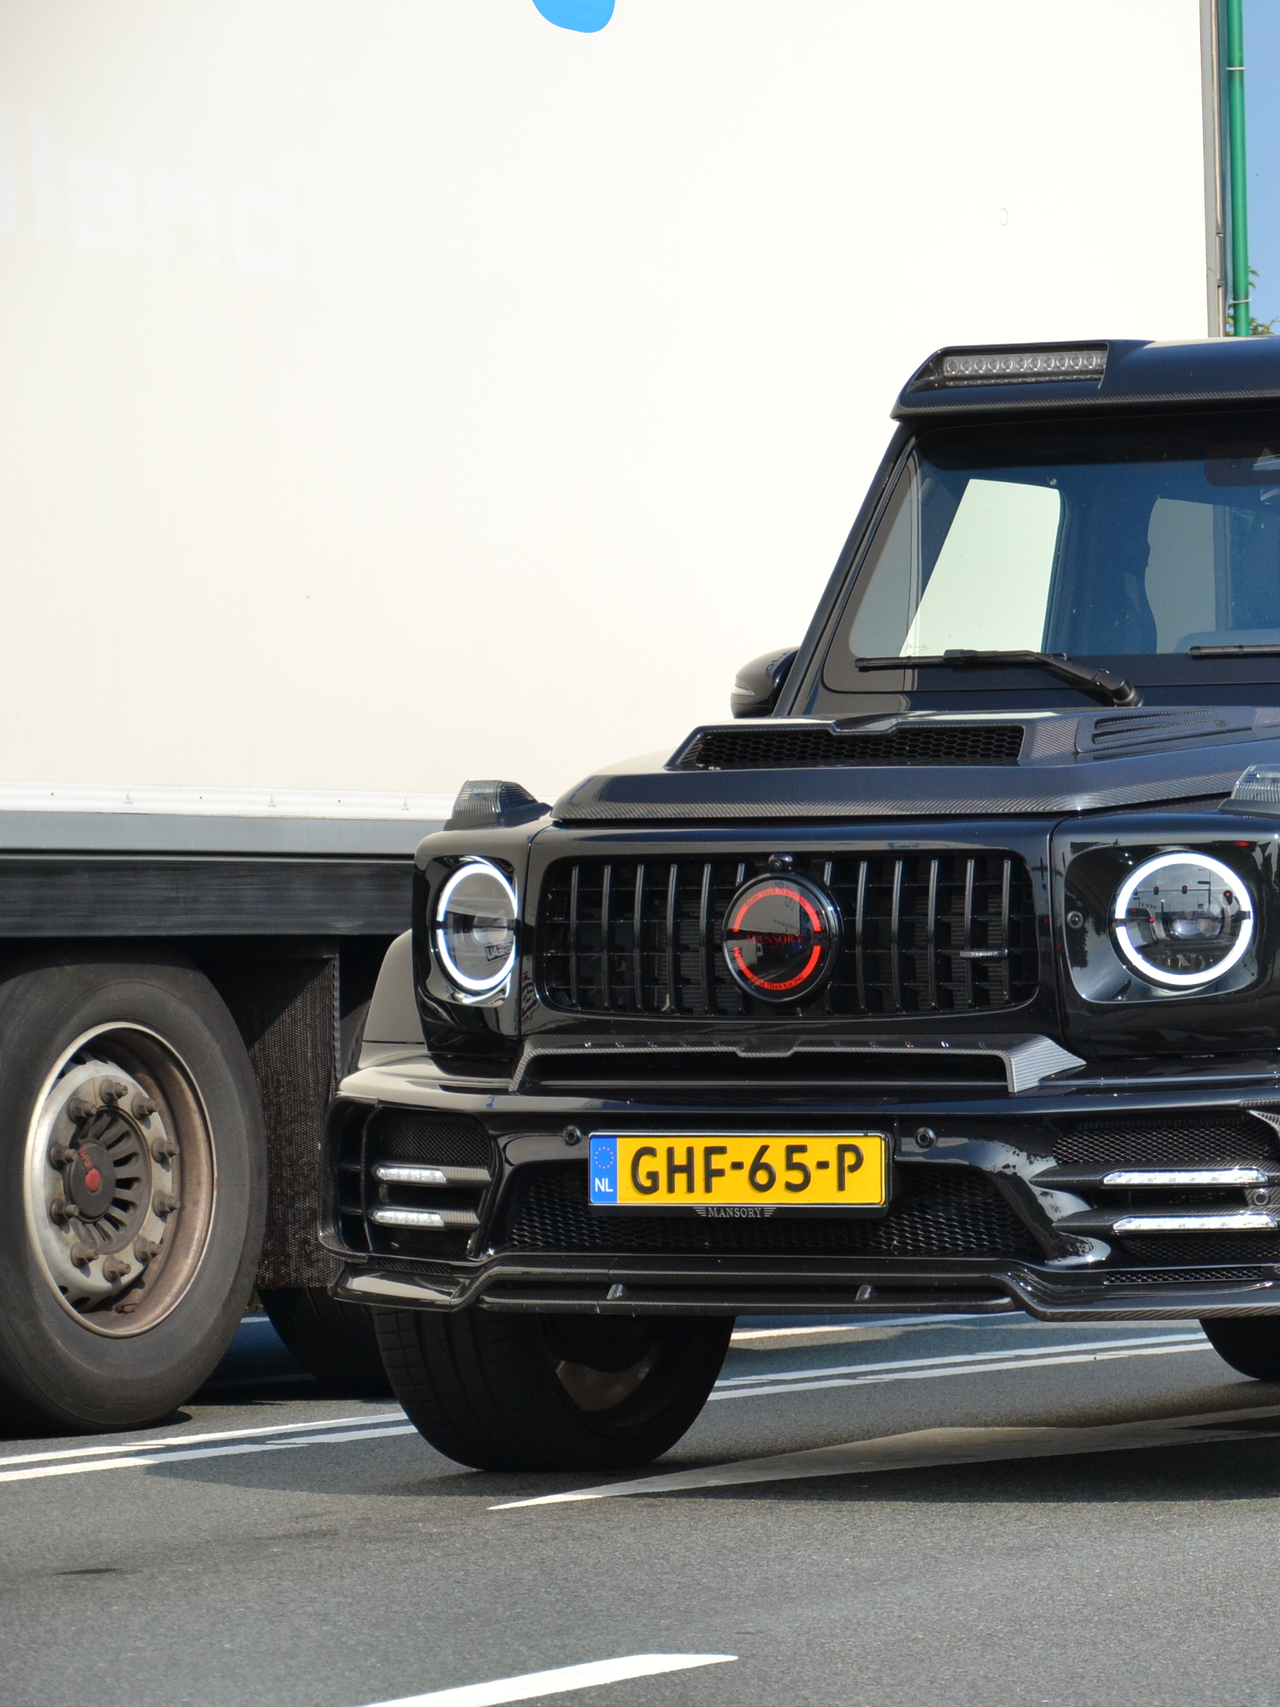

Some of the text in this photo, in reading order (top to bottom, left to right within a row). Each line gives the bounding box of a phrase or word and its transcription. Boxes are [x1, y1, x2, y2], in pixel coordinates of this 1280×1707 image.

[746, 933, 803, 944] MANSORY
[630, 1143, 864, 1195] GHF-65-P
[594, 1178, 613, 1192] NL
[708, 1207, 762, 1218] MANSORY
